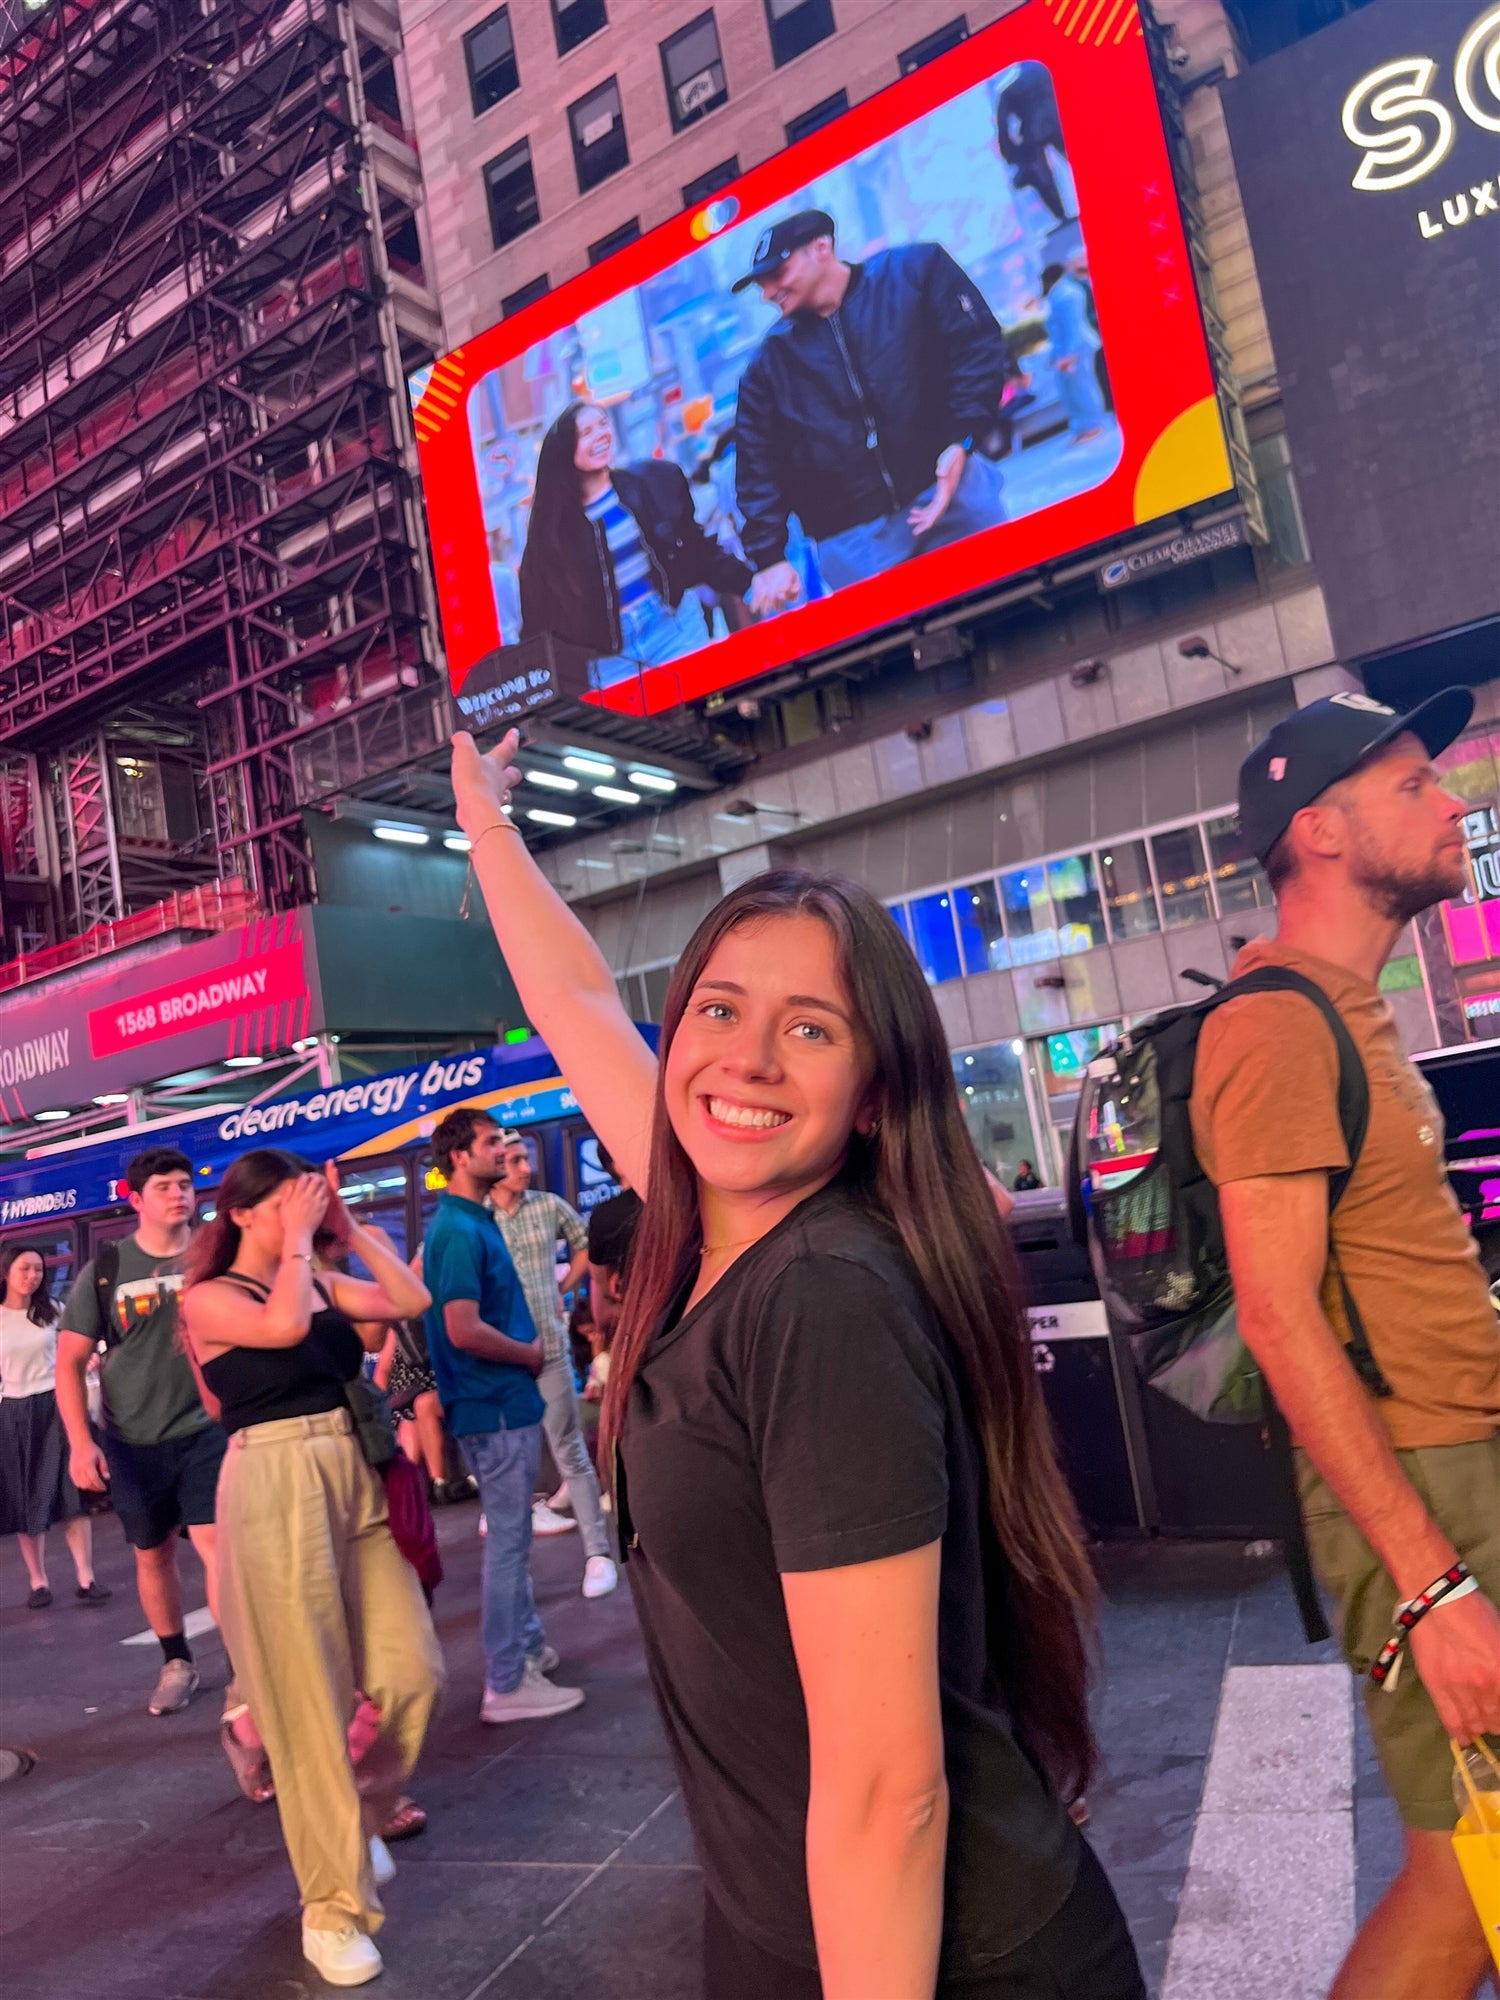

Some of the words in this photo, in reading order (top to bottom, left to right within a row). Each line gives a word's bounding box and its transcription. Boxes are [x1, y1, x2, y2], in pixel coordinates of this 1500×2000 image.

[1418, 174, 1500, 239] LUX
[116, 1005, 156, 1037] 1568
[159, 968, 268, 1024] BROADWAY
[219, 1072, 418, 1141] clean-energy
[419, 1056, 486, 1096] bus
